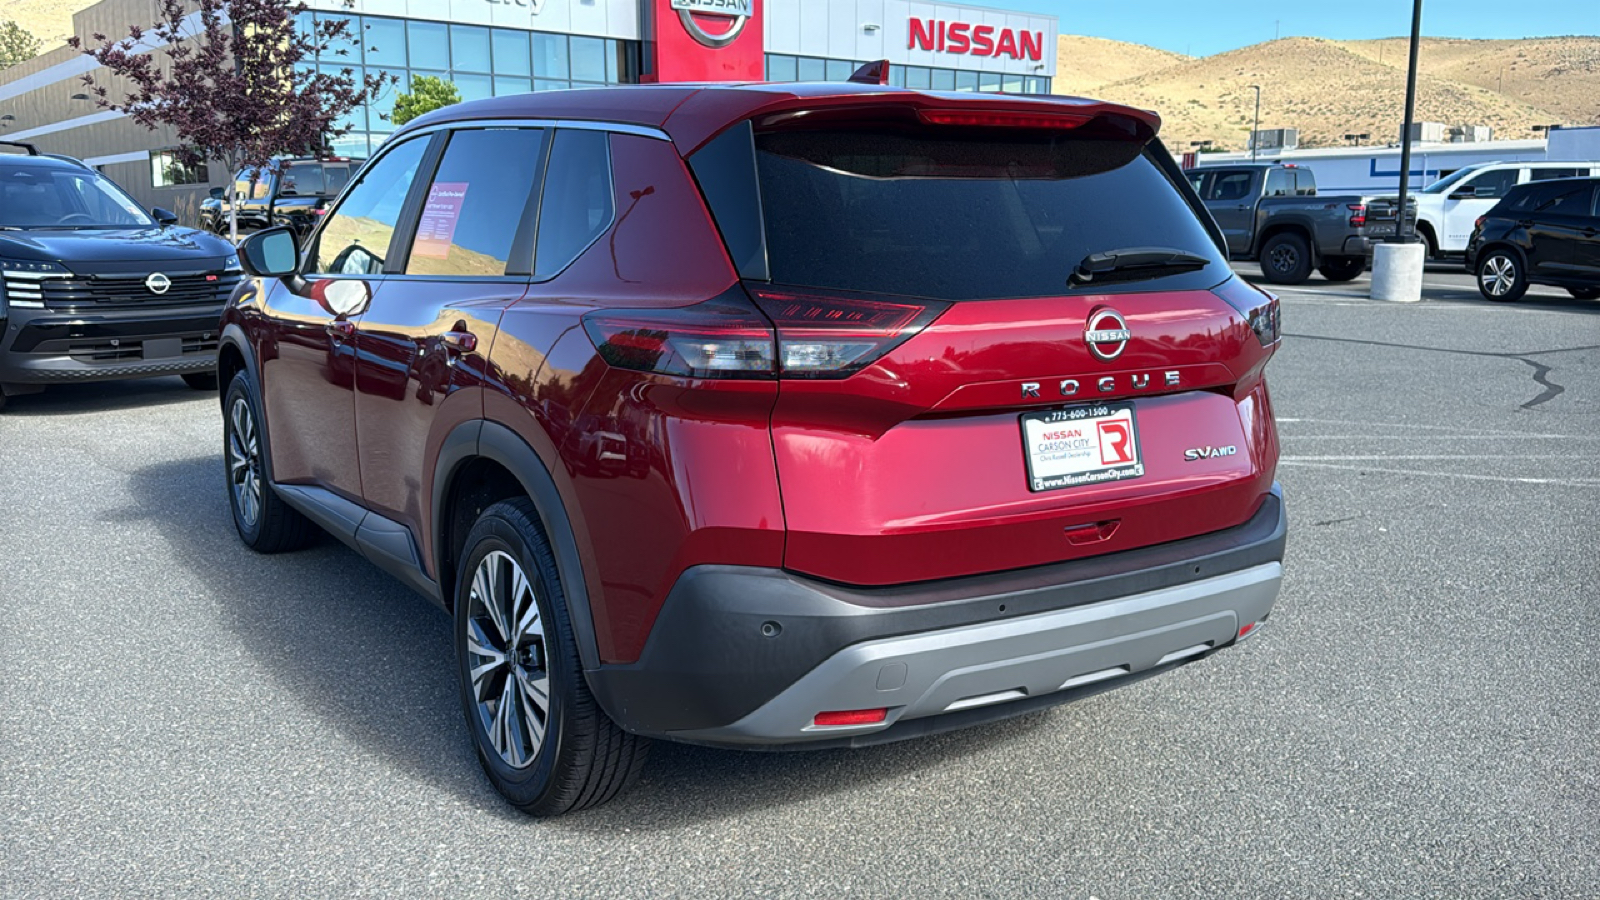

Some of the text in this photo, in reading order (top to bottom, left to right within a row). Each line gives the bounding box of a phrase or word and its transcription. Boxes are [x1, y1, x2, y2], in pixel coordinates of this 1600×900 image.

[907, 17, 1043, 61] NISSAN
[1088, 331, 1130, 341] NISSAN
[1021, 370, 1180, 398] ROGUE
[1051, 406, 1108, 421] 775-600-1500
[1042, 429, 1082, 441] NISSAN
[1038, 438, 1090, 452] CARSON CITY
[1044, 468, 1135, 487] www.NissanCarsonCity.com
